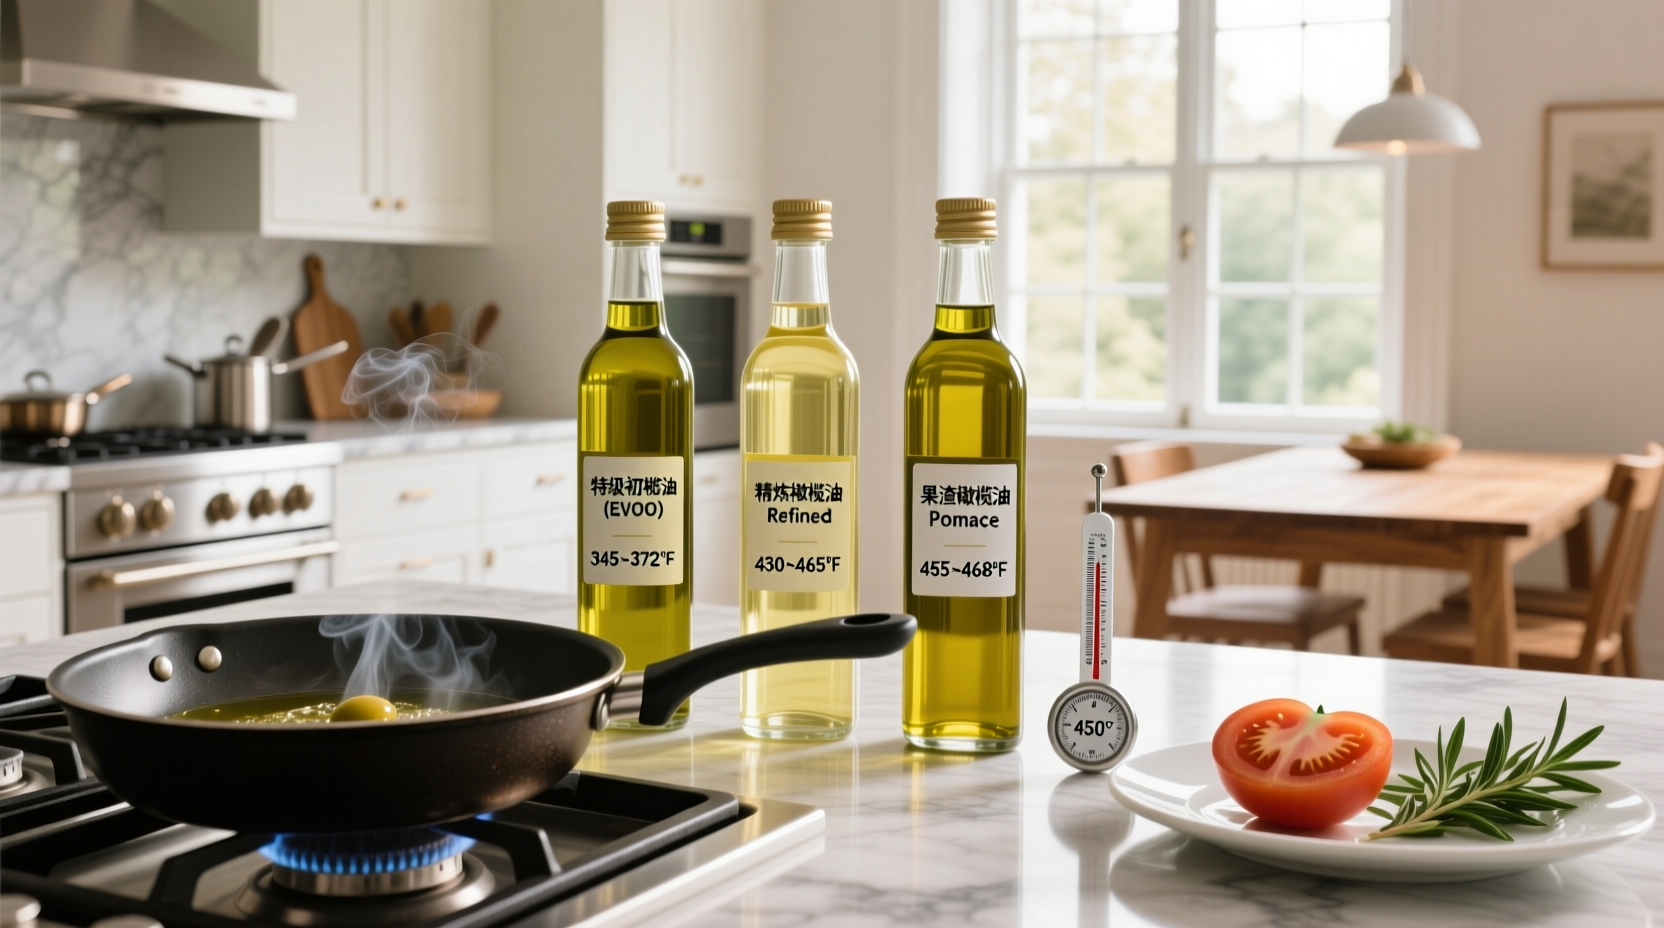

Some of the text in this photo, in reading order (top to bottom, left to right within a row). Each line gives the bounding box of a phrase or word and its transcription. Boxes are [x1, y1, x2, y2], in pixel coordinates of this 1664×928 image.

[604, 500, 663, 519] (EVOO)
[767, 507, 832, 523] Refined
[929, 510, 999, 528] Pomace
